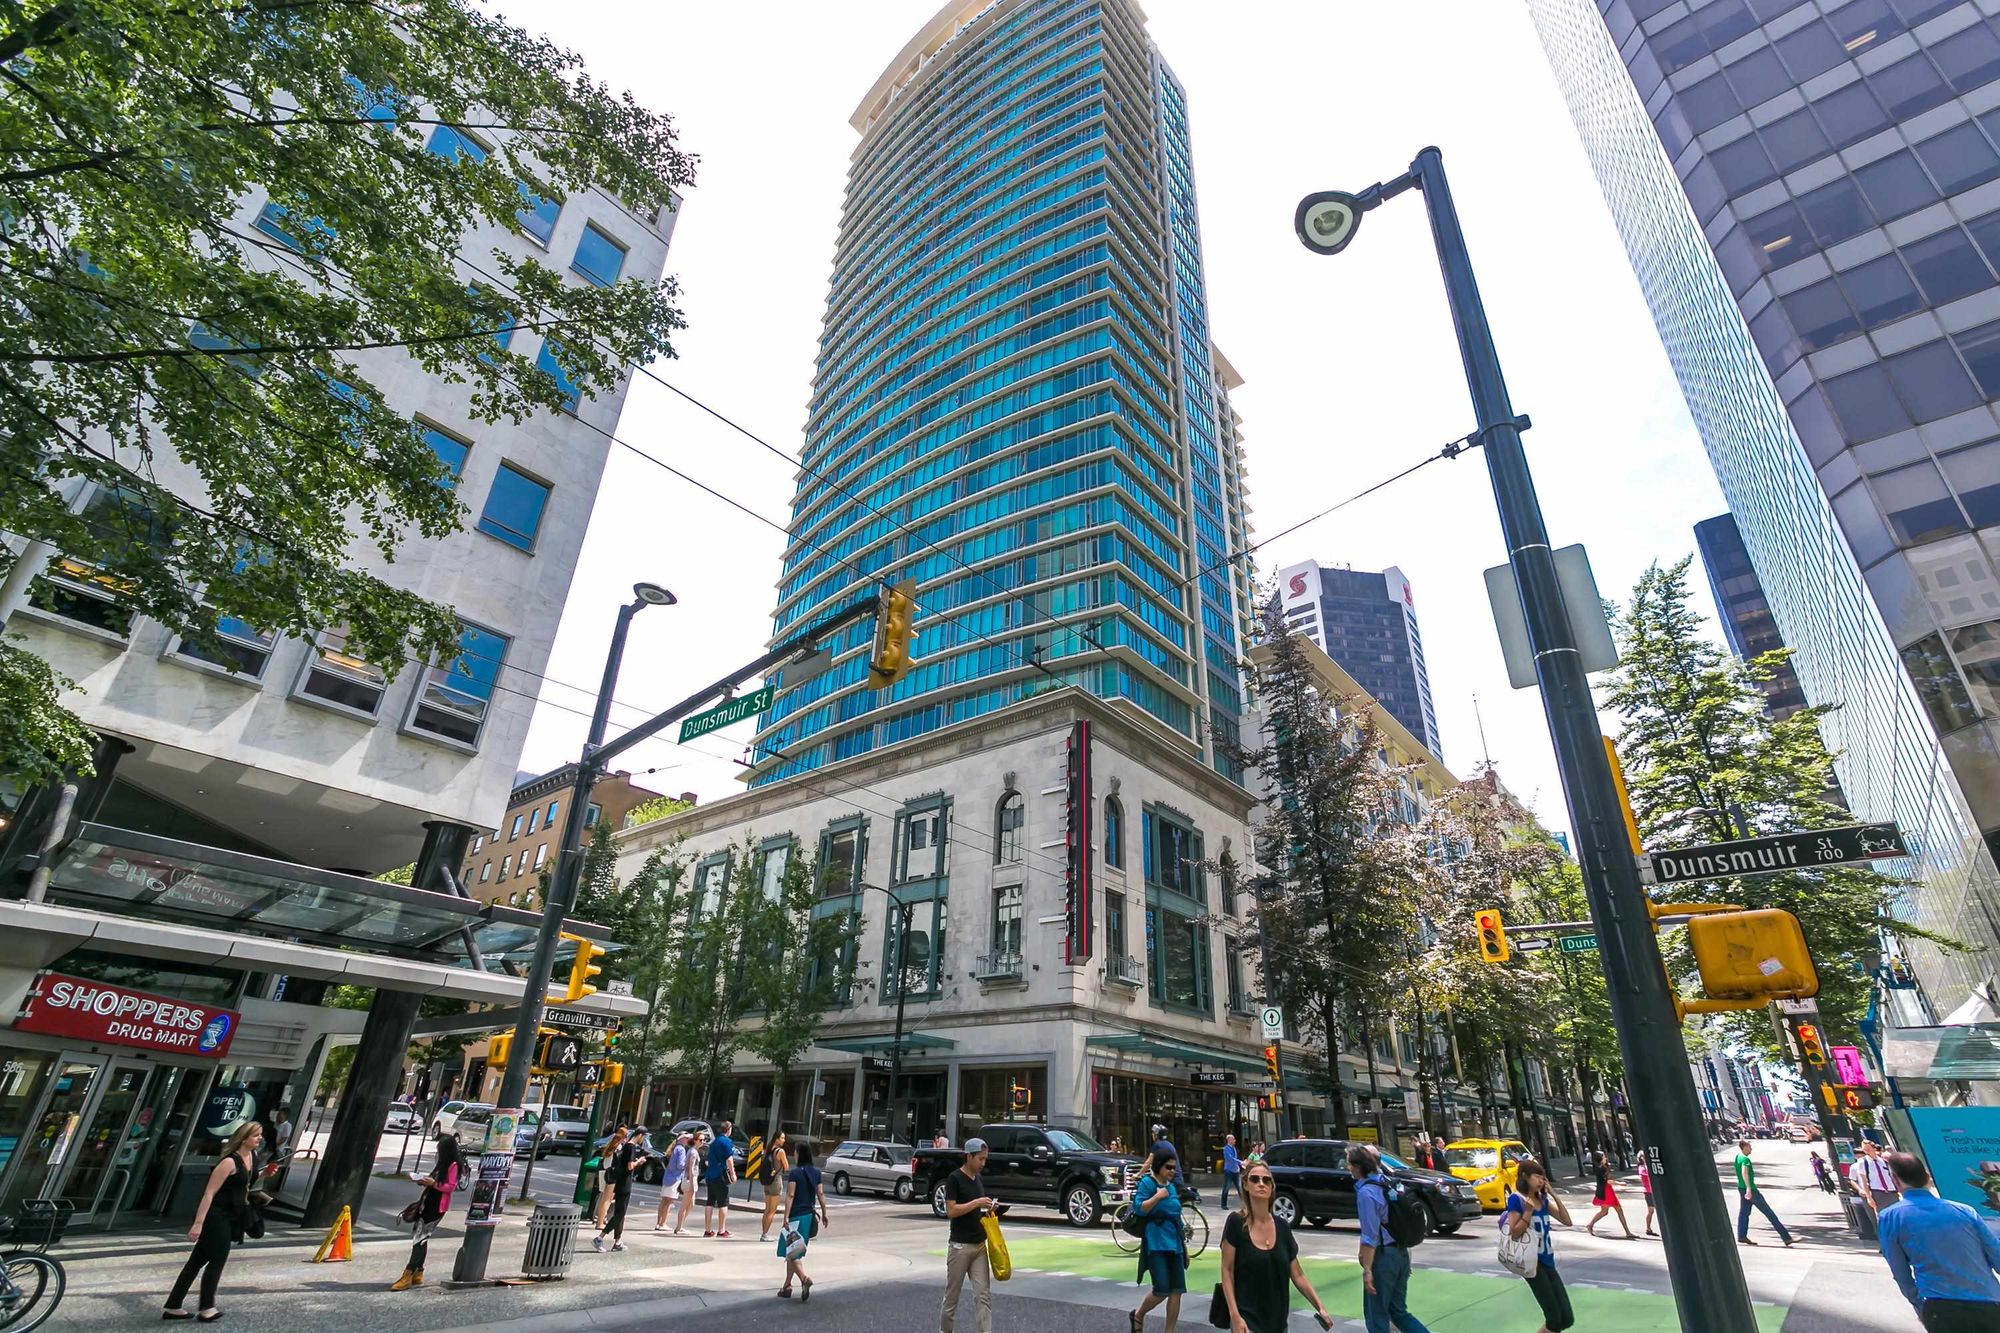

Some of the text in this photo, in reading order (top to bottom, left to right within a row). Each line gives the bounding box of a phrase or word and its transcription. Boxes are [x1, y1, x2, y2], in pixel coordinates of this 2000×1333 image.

[684, 691, 768, 738] Dunsmuir St
[1660, 836, 1834, 880] Dunsmuir St
[1814, 847, 1844, 862] 700
[1567, 938, 1598, 950] Duns
[46, 982, 205, 1031] SHOPPERS
[548, 1010, 592, 1025] Granville
[107, 1021, 198, 1048] DRUG MART
[873, 1059, 884, 1067] THE
[1212, 1073, 1225, 1081] KEG
[212, 1096, 243, 1106] OPEN
[222, 1110, 238, 1120] 10
[1648, 1146, 1659, 1158] 37
[1651, 1162, 1664, 1175] 05
